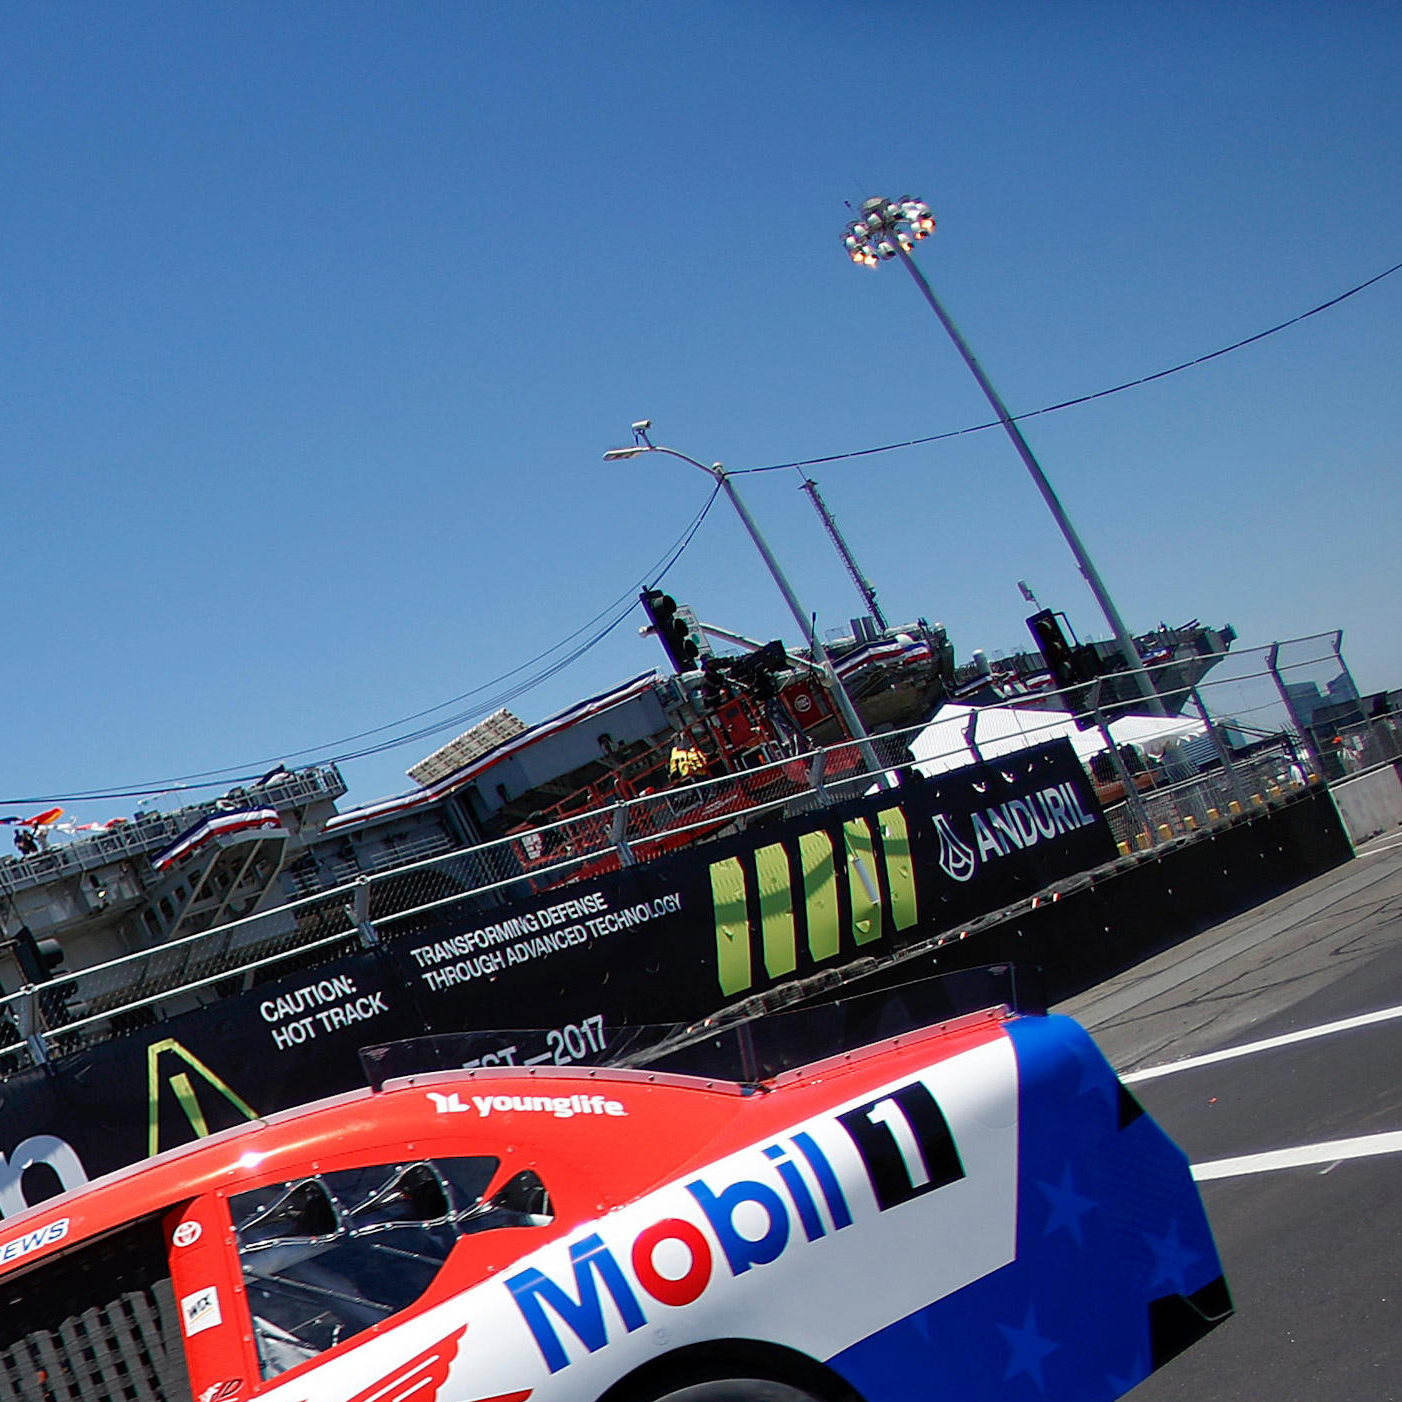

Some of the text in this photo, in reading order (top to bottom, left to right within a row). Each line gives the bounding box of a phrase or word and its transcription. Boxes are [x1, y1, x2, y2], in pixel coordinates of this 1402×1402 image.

[972, 780, 1095, 864] ANDURIL
[410, 892, 608, 968] TRANSFORMING DEFENSE
[421, 893, 682, 993] THROUGH ADVANCED TECHNOLOGY
[260, 975, 357, 1022] CAUTION:
[271, 991, 389, 1050] HOT TRACK
[471, 1094, 630, 1118] younglife
[504, 1131, 854, 1376] Mobil
